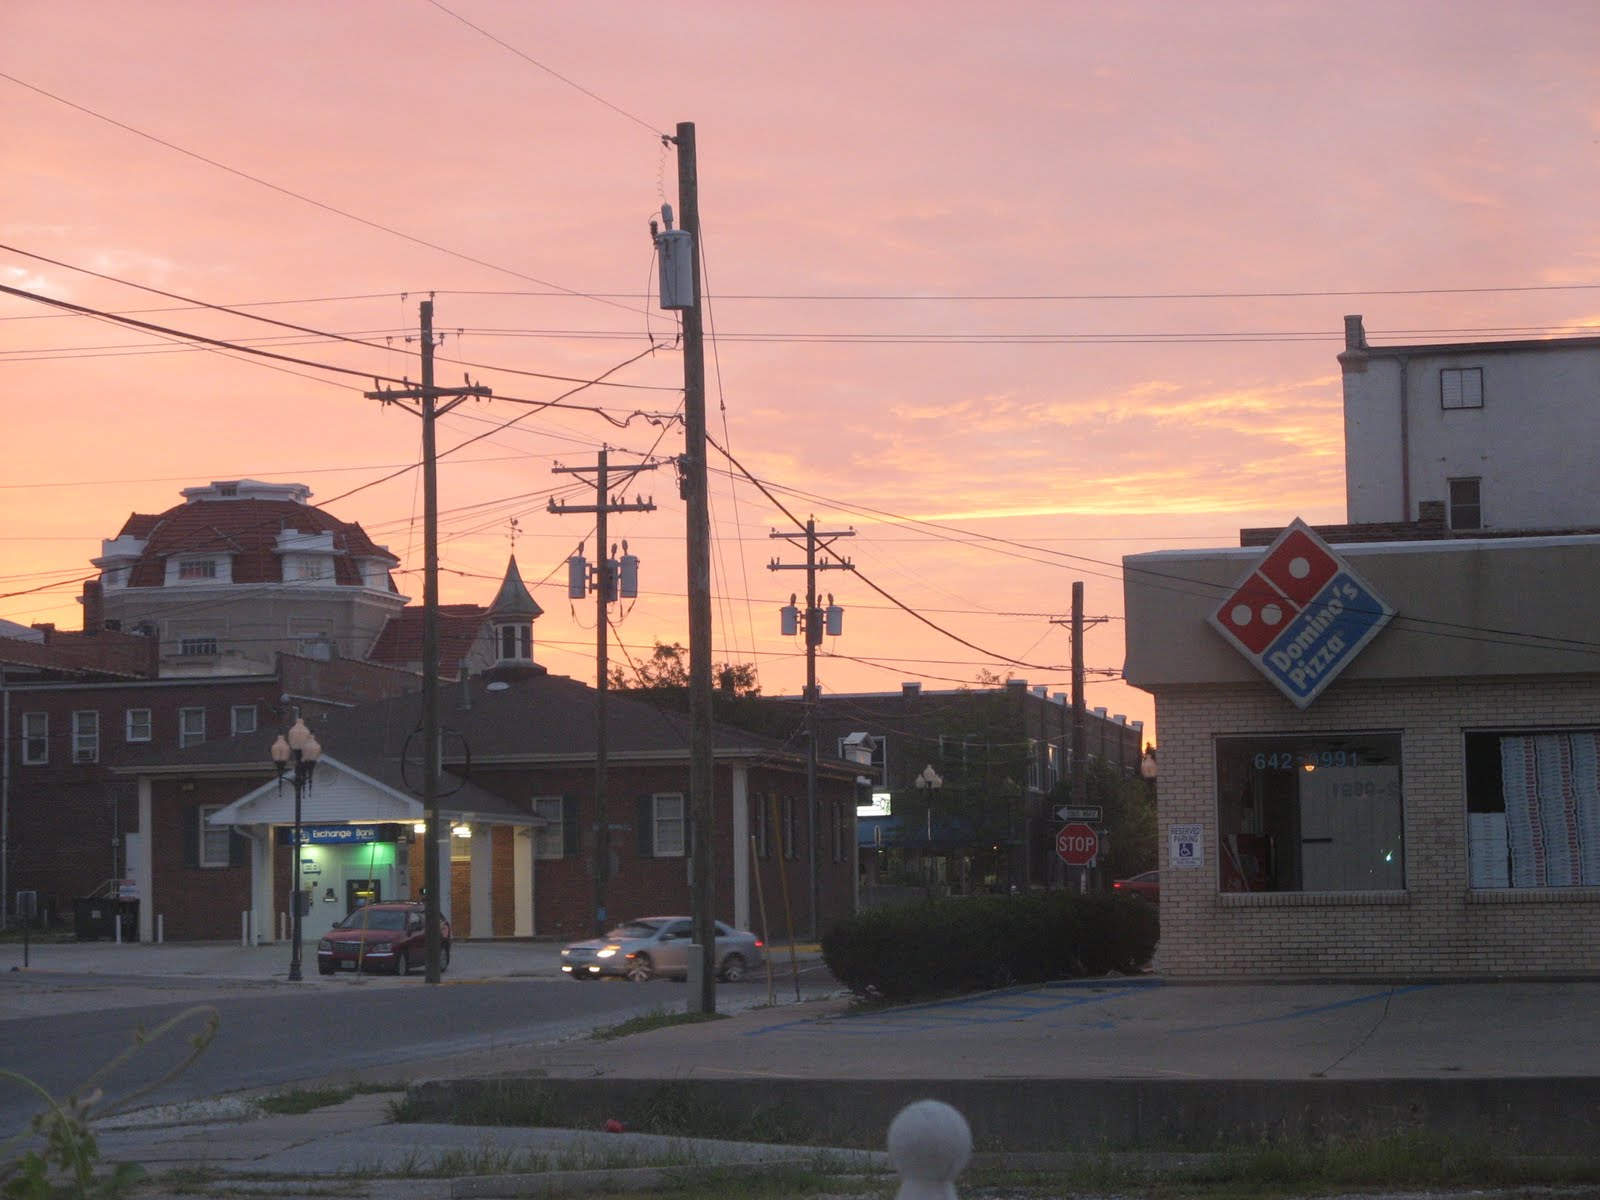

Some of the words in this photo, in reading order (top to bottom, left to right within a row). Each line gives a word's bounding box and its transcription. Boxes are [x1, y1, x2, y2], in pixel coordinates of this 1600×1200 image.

[1269, 583, 1358, 673] Domino's
[1288, 635, 1345, 690] Pizza
[313, 831, 351, 839] Exchange
[1171, 827, 1201, 835] RESERVED
[1059, 837, 1094, 852] STOP
[1174, 835, 1199, 843] PARKING
